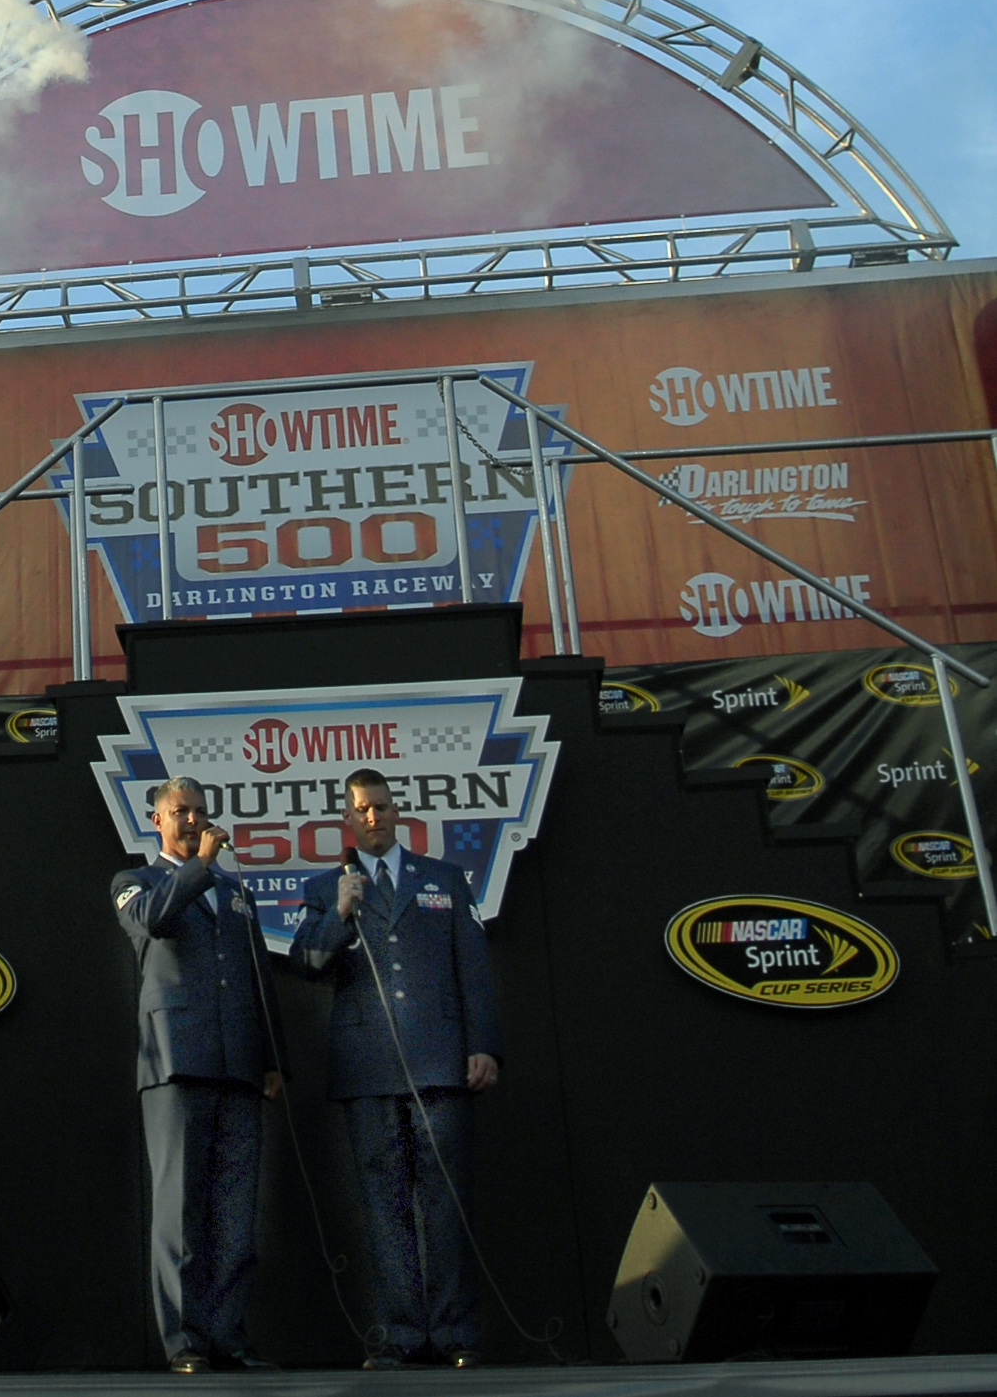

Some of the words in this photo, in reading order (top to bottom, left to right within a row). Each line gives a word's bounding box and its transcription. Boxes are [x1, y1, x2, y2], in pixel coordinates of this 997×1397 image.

[80, 83, 489, 217] SHOWTIME
[649, 366, 838, 427] SHOWTIME
[209, 403, 401, 466] SHOWTIME
[89, 460, 536, 525] SOUTHERN
[679, 462, 849, 499] DARLINGTON
[777, 493, 802, 511] to
[197, 511, 437, 575] 500
[146, 582, 337, 608] DARLINGTON
[353, 572, 494, 596] RACEWY
[679, 572, 871, 638] SHOWTIME
[712, 687, 779, 713] Sprint
[894, 681, 926, 693] Sprint
[599, 699, 629, 712] Sprint
[243, 718, 400, 773] SHOWTIME
[877, 760, 947, 787] Sprint
[925, 851, 957, 864] Sprint
[730, 919, 803, 941] NASCAR
[745, 944, 821, 974] Sprint
[760, 984, 801, 996] CUP
[803, 981, 873, 994] SERIES
